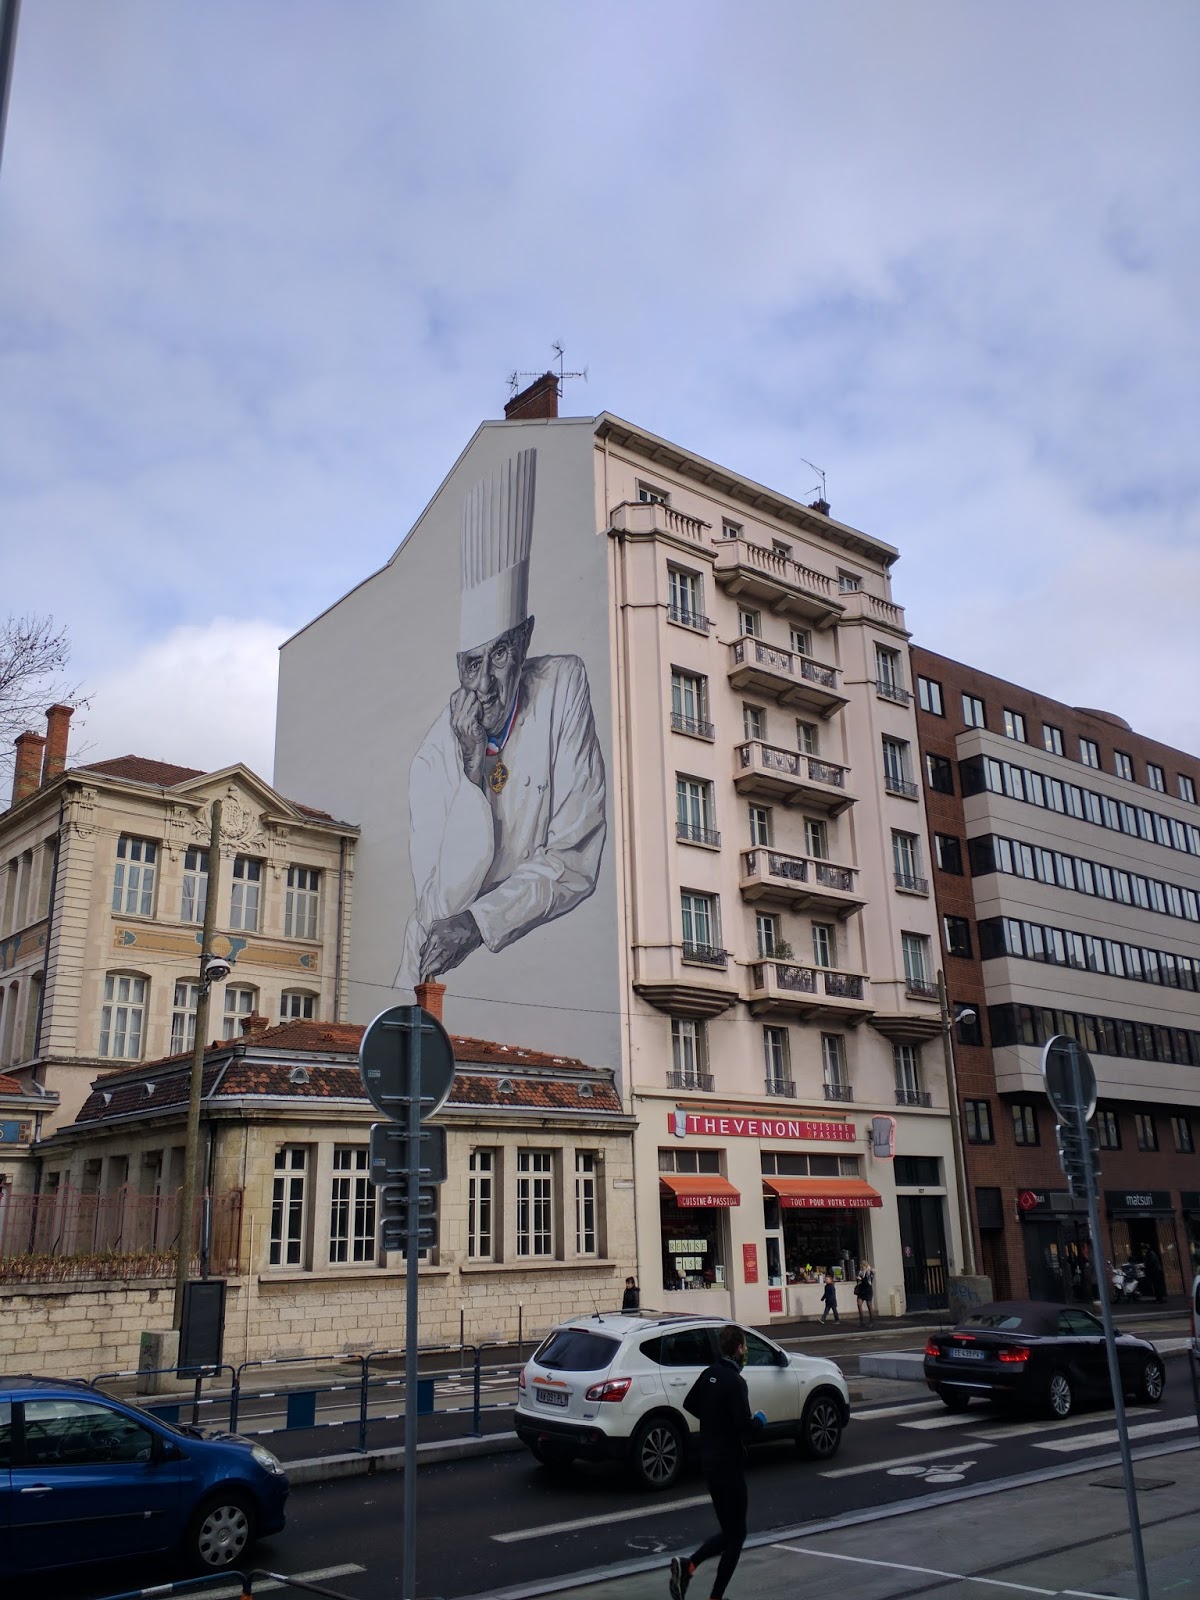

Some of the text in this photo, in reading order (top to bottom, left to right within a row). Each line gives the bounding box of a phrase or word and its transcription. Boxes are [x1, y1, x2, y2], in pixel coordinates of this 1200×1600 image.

[689, 1115, 848, 1137] THEVENON CUISINE
[682, 1197, 706, 1206] CUISINE
[790, 1198, 874, 1206] TOUT POUR VOTRE CUISINE
[1126, 1192, 1153, 1206] matsuri
[669, 1242, 706, 1251] REMISE
